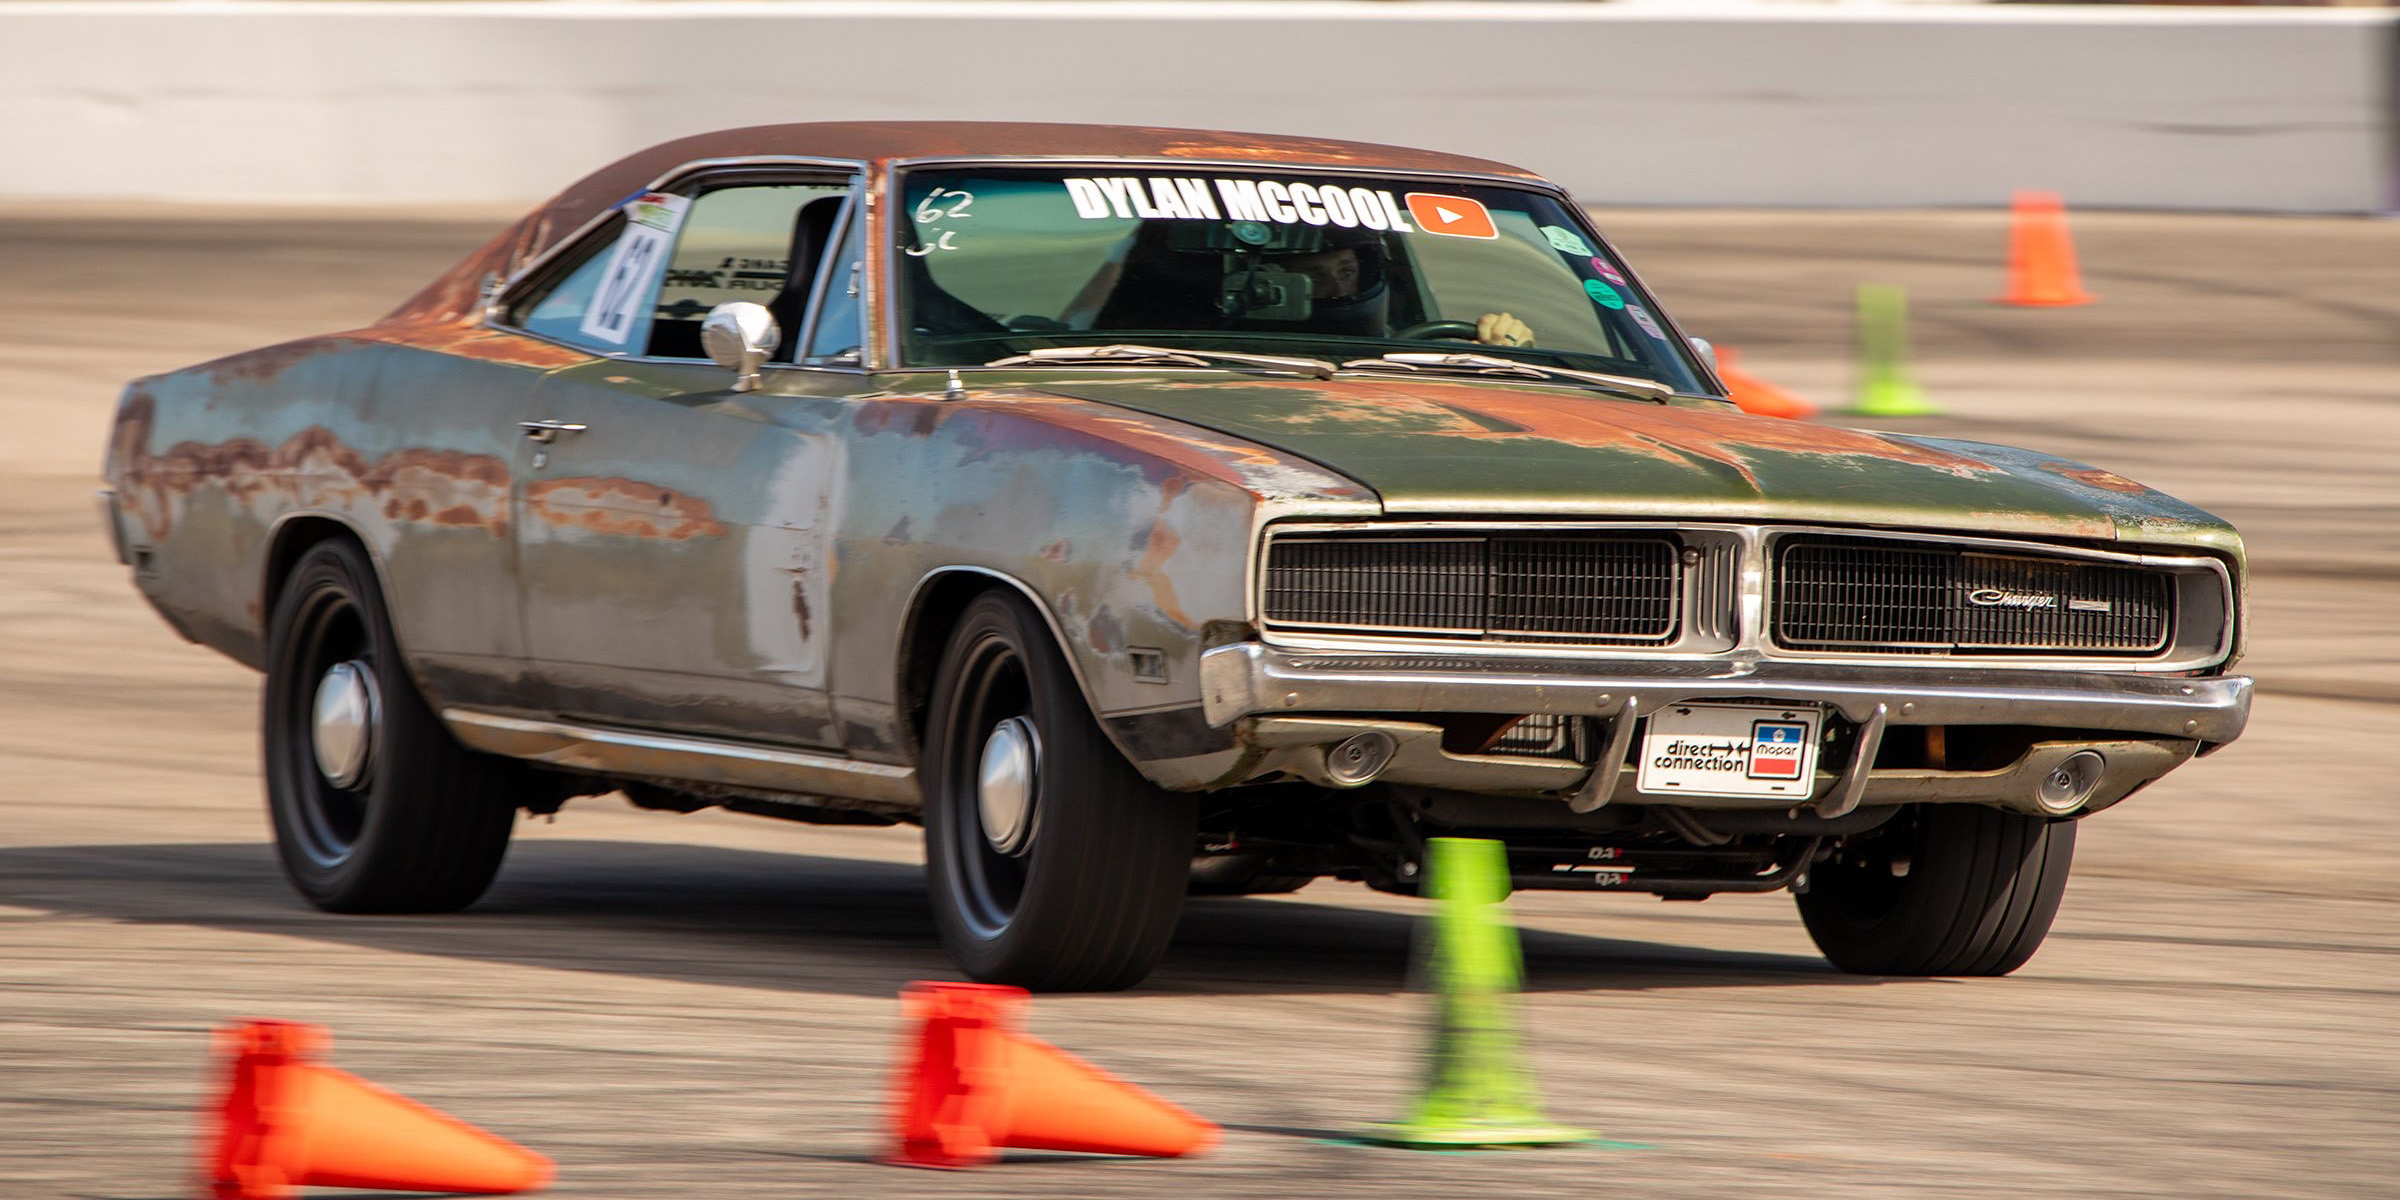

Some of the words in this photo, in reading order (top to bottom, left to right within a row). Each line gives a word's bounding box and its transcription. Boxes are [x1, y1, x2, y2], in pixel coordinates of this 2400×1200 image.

[915, 187, 974, 223] 62
[1063, 177, 1222, 219] DYLAN
[1214, 179, 1414, 232] MCCOOL
[1969, 588, 2058, 612] Charger
[1667, 740, 1713, 757] direct
[1655, 755, 1744, 772] connection
